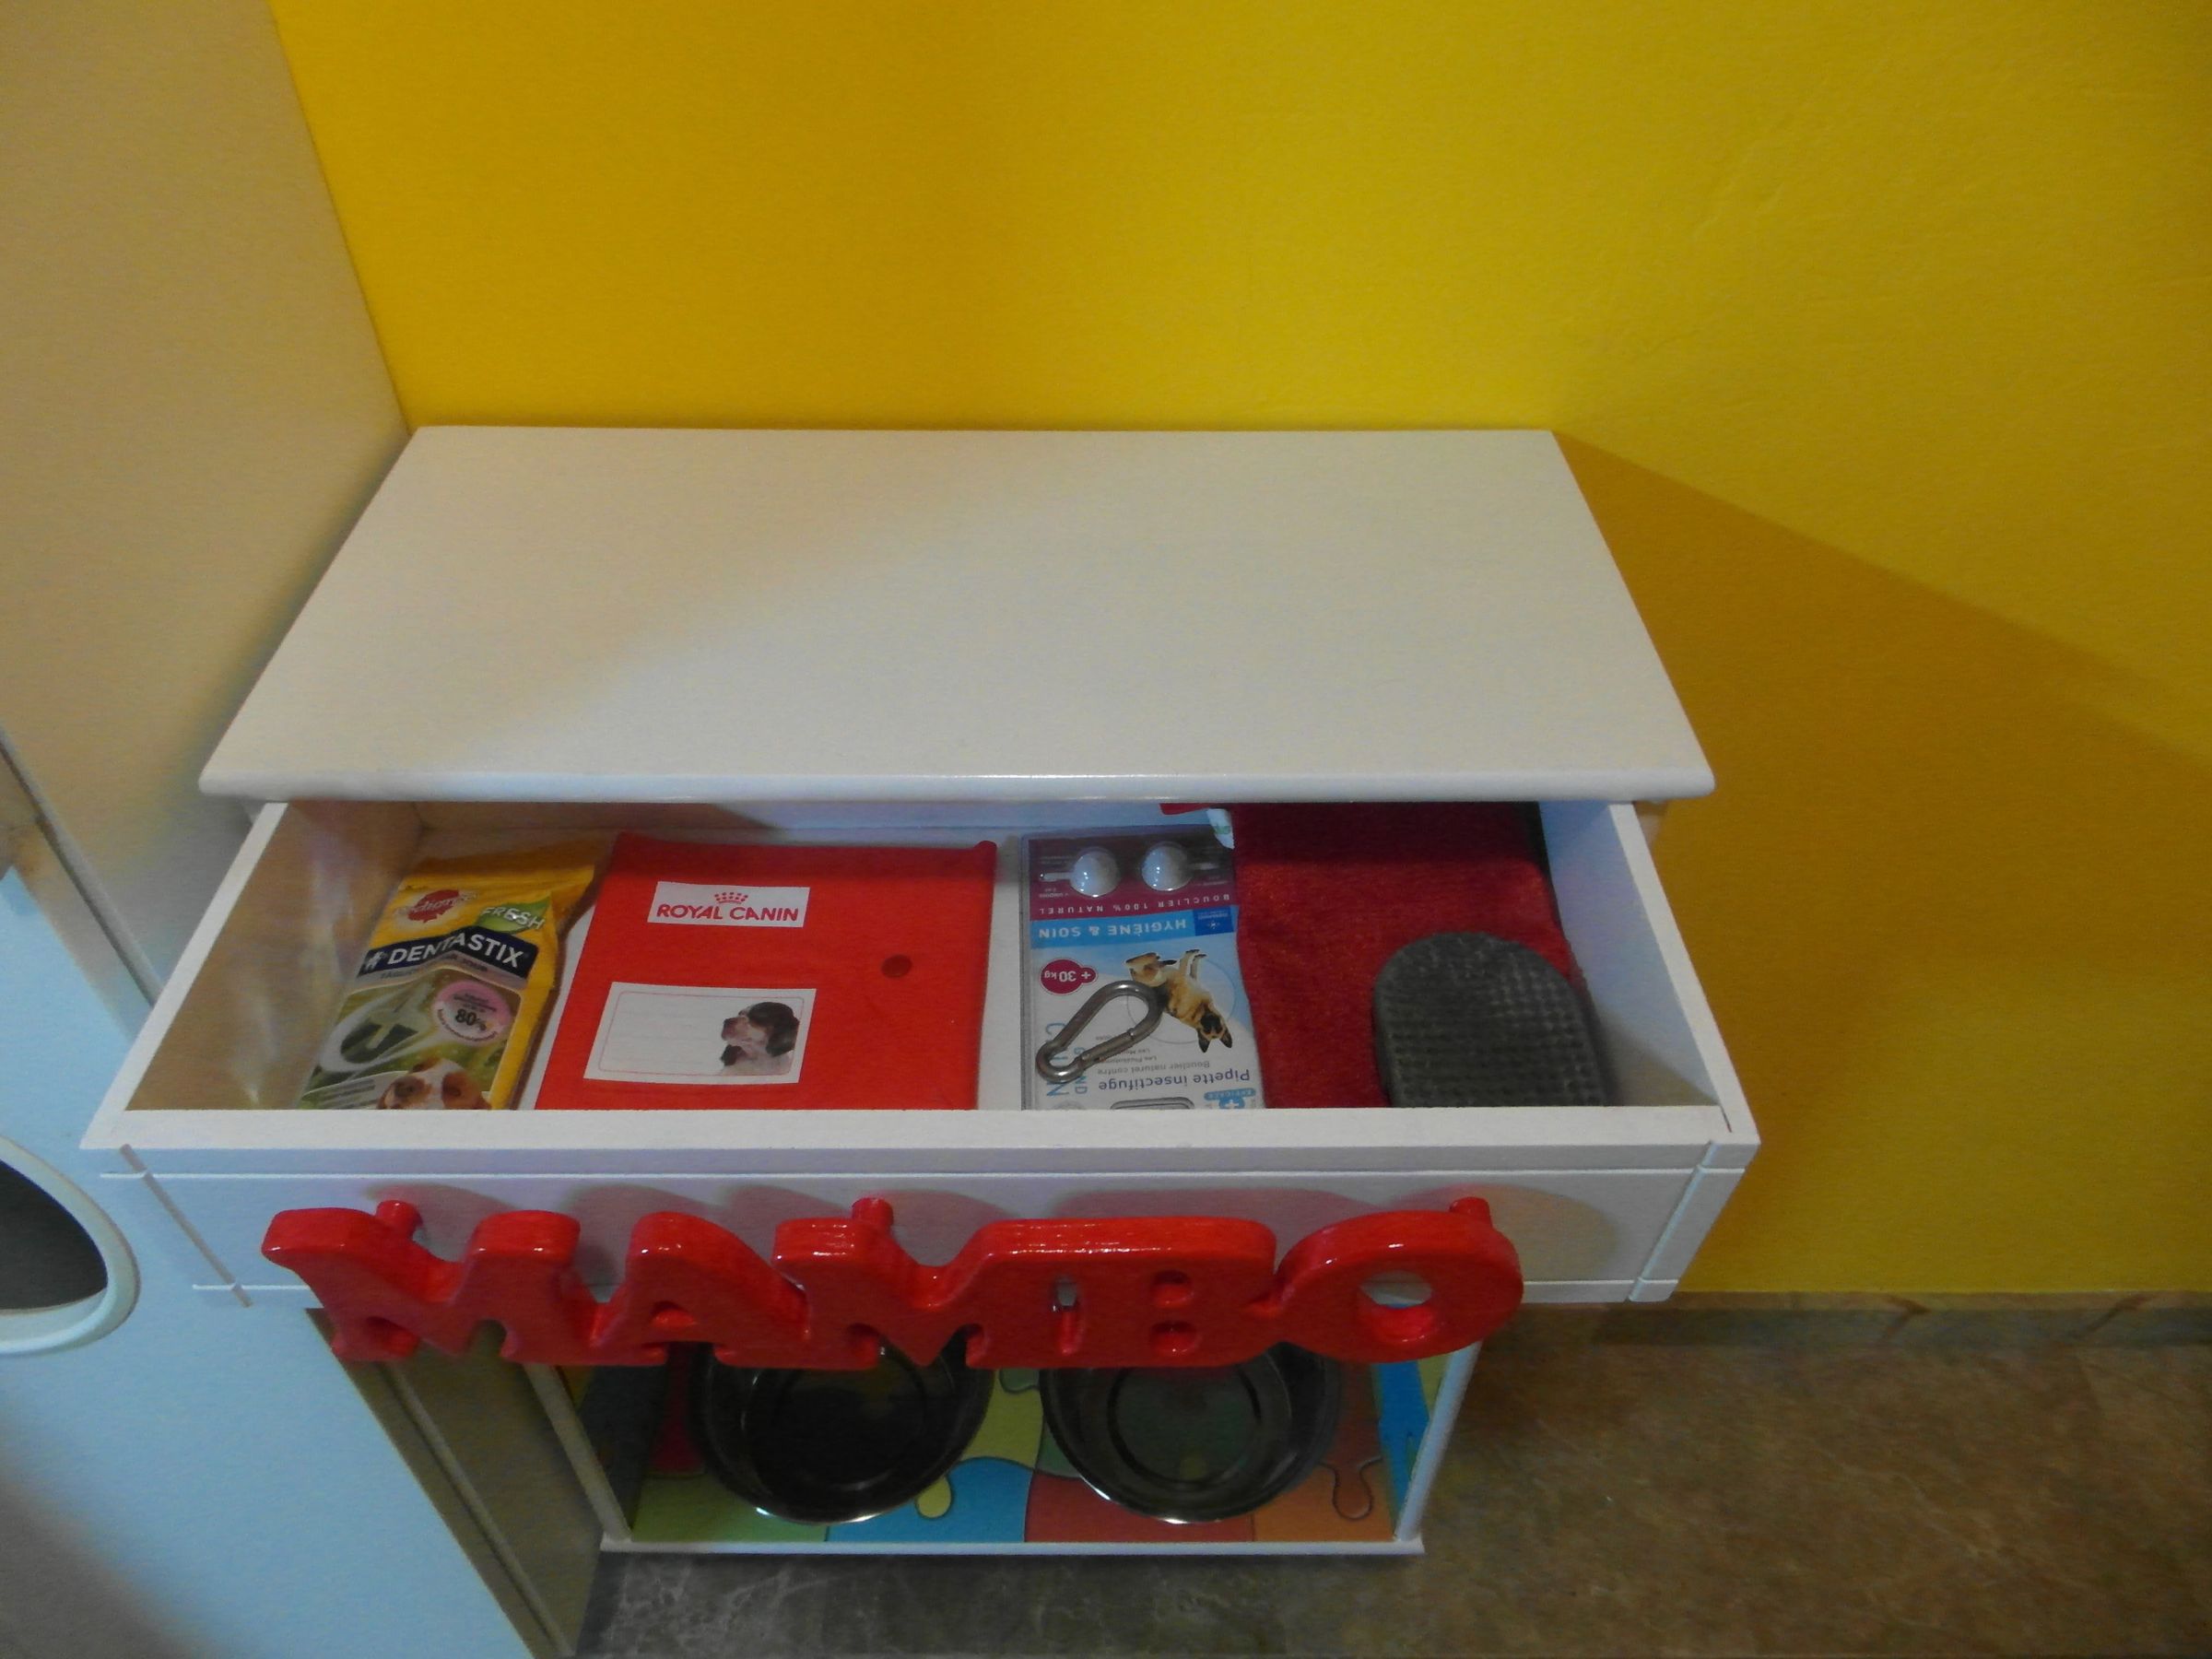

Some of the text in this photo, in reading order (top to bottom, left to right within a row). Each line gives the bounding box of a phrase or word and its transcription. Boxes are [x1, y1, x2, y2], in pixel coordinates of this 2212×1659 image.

[656, 903, 799, 922] ROYAL CANIN
[1039, 893, 1230, 915] BOUCLIER 100% NATUREL
[481, 906, 546, 930] FRESH
[1038, 918, 1187, 938] HYGIÈNE & SOIN
[387, 932, 524, 968] DENTASTIX
[1130, 1064, 1166, 1074] naturel
[1169, 1060, 1210, 1071] Bouclier
[1098, 1069, 1250, 1091] Pipette insectifuge
